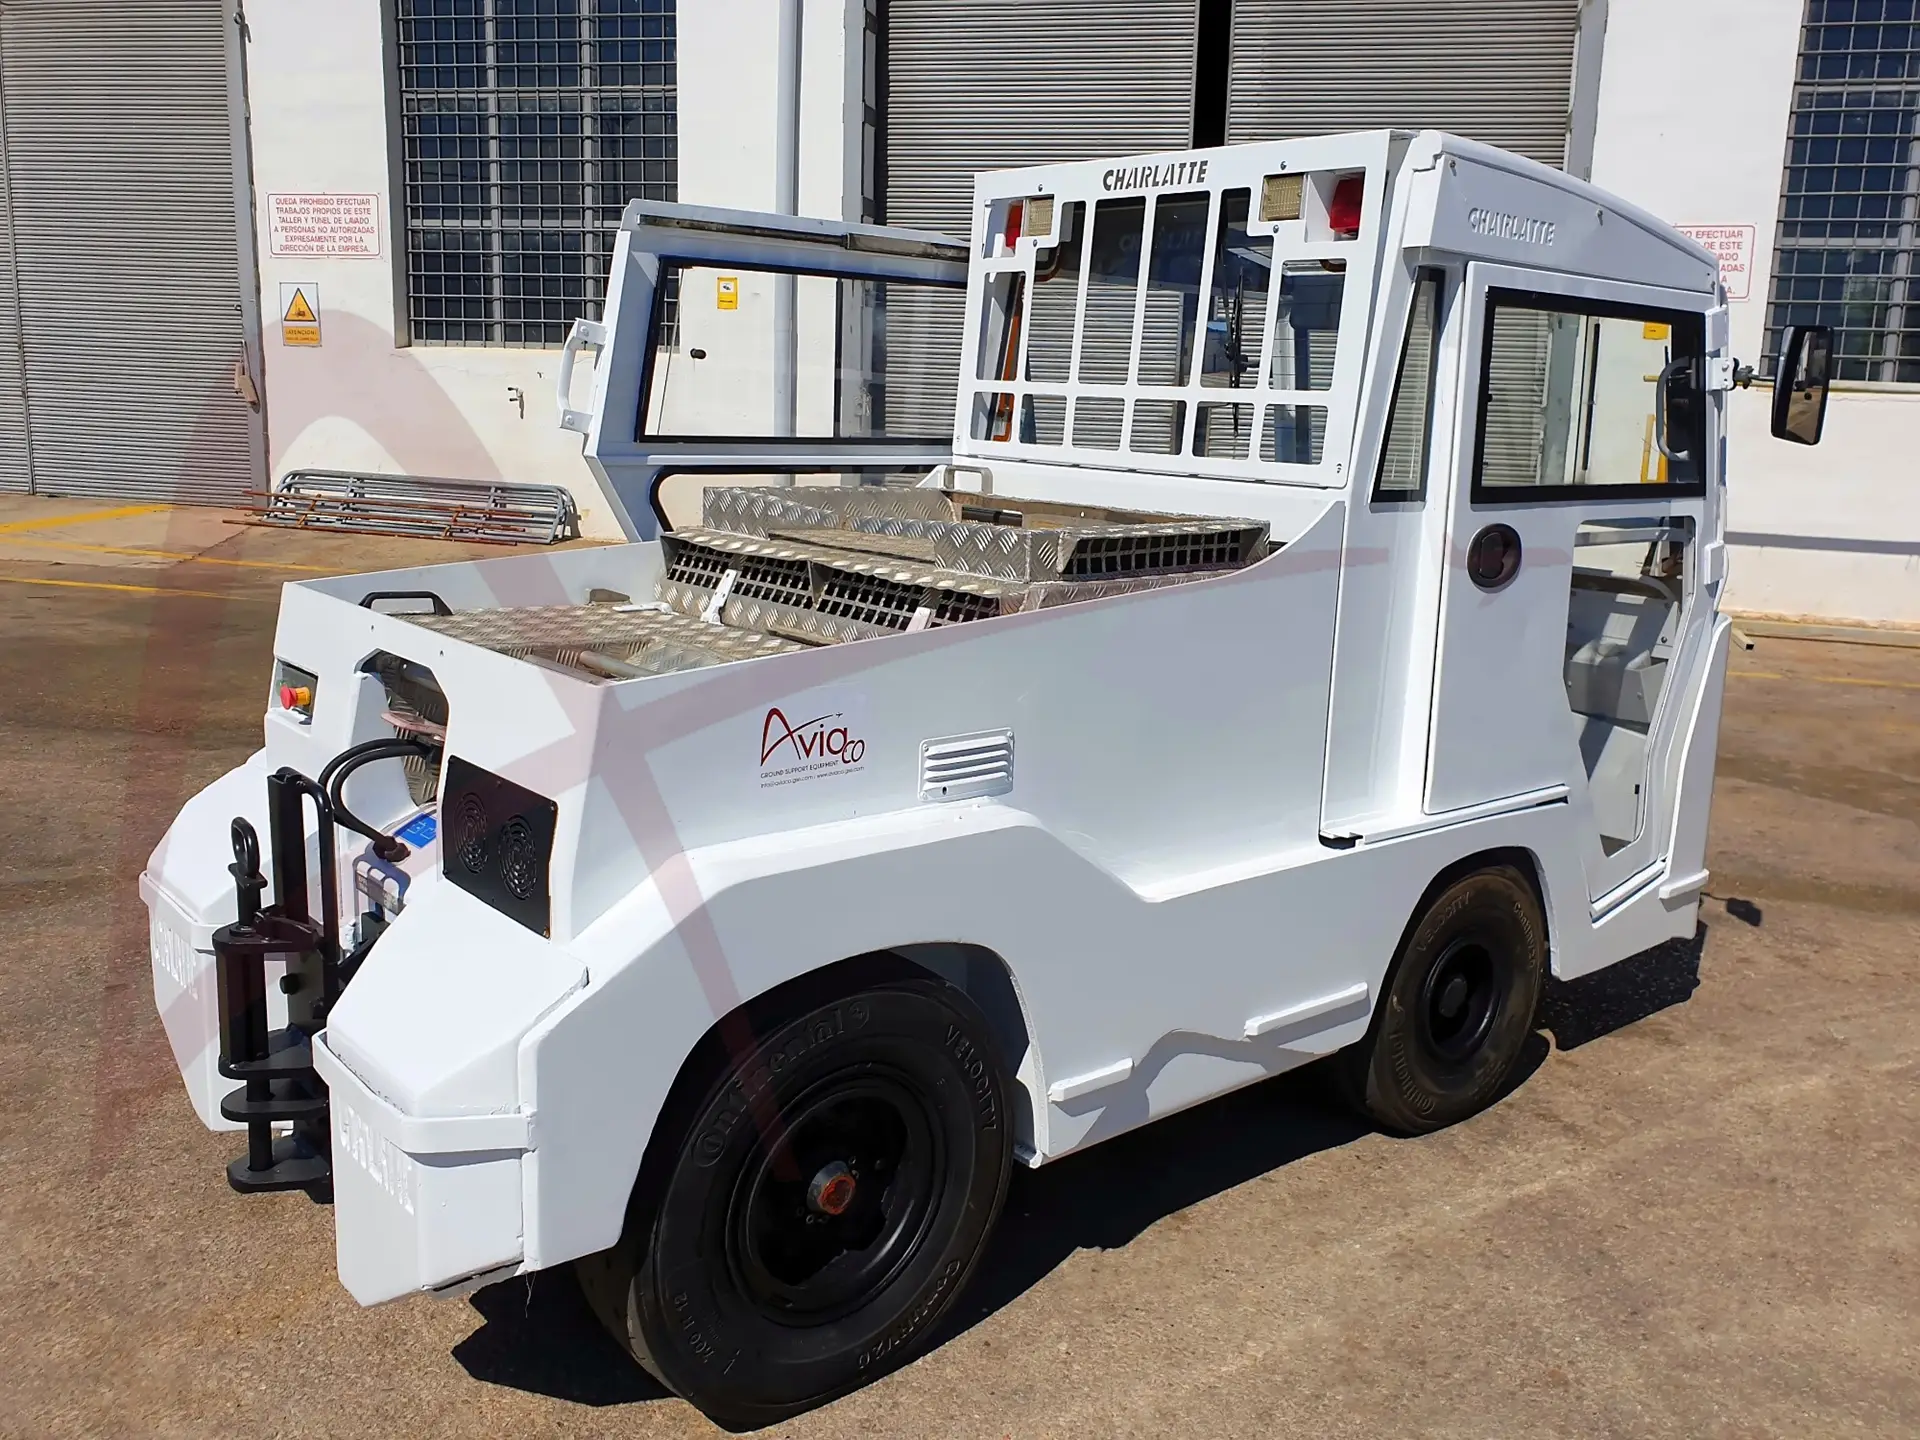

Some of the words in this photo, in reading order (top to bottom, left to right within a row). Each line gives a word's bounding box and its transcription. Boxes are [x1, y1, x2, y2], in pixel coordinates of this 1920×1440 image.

[1102, 160, 1209, 191] CHARLATTE
[275, 198, 297, 206] QUEDA
[300, 198, 335, 206] PROHIBIDO
[336, 198, 371, 206] EFECTUAR
[276, 207, 311, 215] TRABAJOS
[312, 207, 342, 215] PROPIOS
[343, 207, 353, 215] DE
[354, 207, 371, 215] ESTE
[278, 216, 304, 224] TALLER
[345, 217, 370, 225] LAVADO
[281, 226, 315, 234] PERSONAS
[318, 226, 327, 234] NO
[330, 226, 375, 234] AUTORIZADAS
[1468, 207, 1556, 247] CHARLATTE
[285, 235, 337, 243] EXPRESAMENTE
[339, 235, 353, 243] POR
[1695, 230, 1744, 239] EFECTUAR
[316, 244, 325, 252] DE
[327, 244, 336, 252] LA
[338, 244, 370, 253] EMPRESA.
[1719, 241, 1743, 250] ESTE
[760, 769, 784, 779] GROUND
[785, 765, 809, 775] SUPPORT
[809, 759, 839, 771] EQUIPMENT
[945, 1024, 997, 1131] VELOCITY
